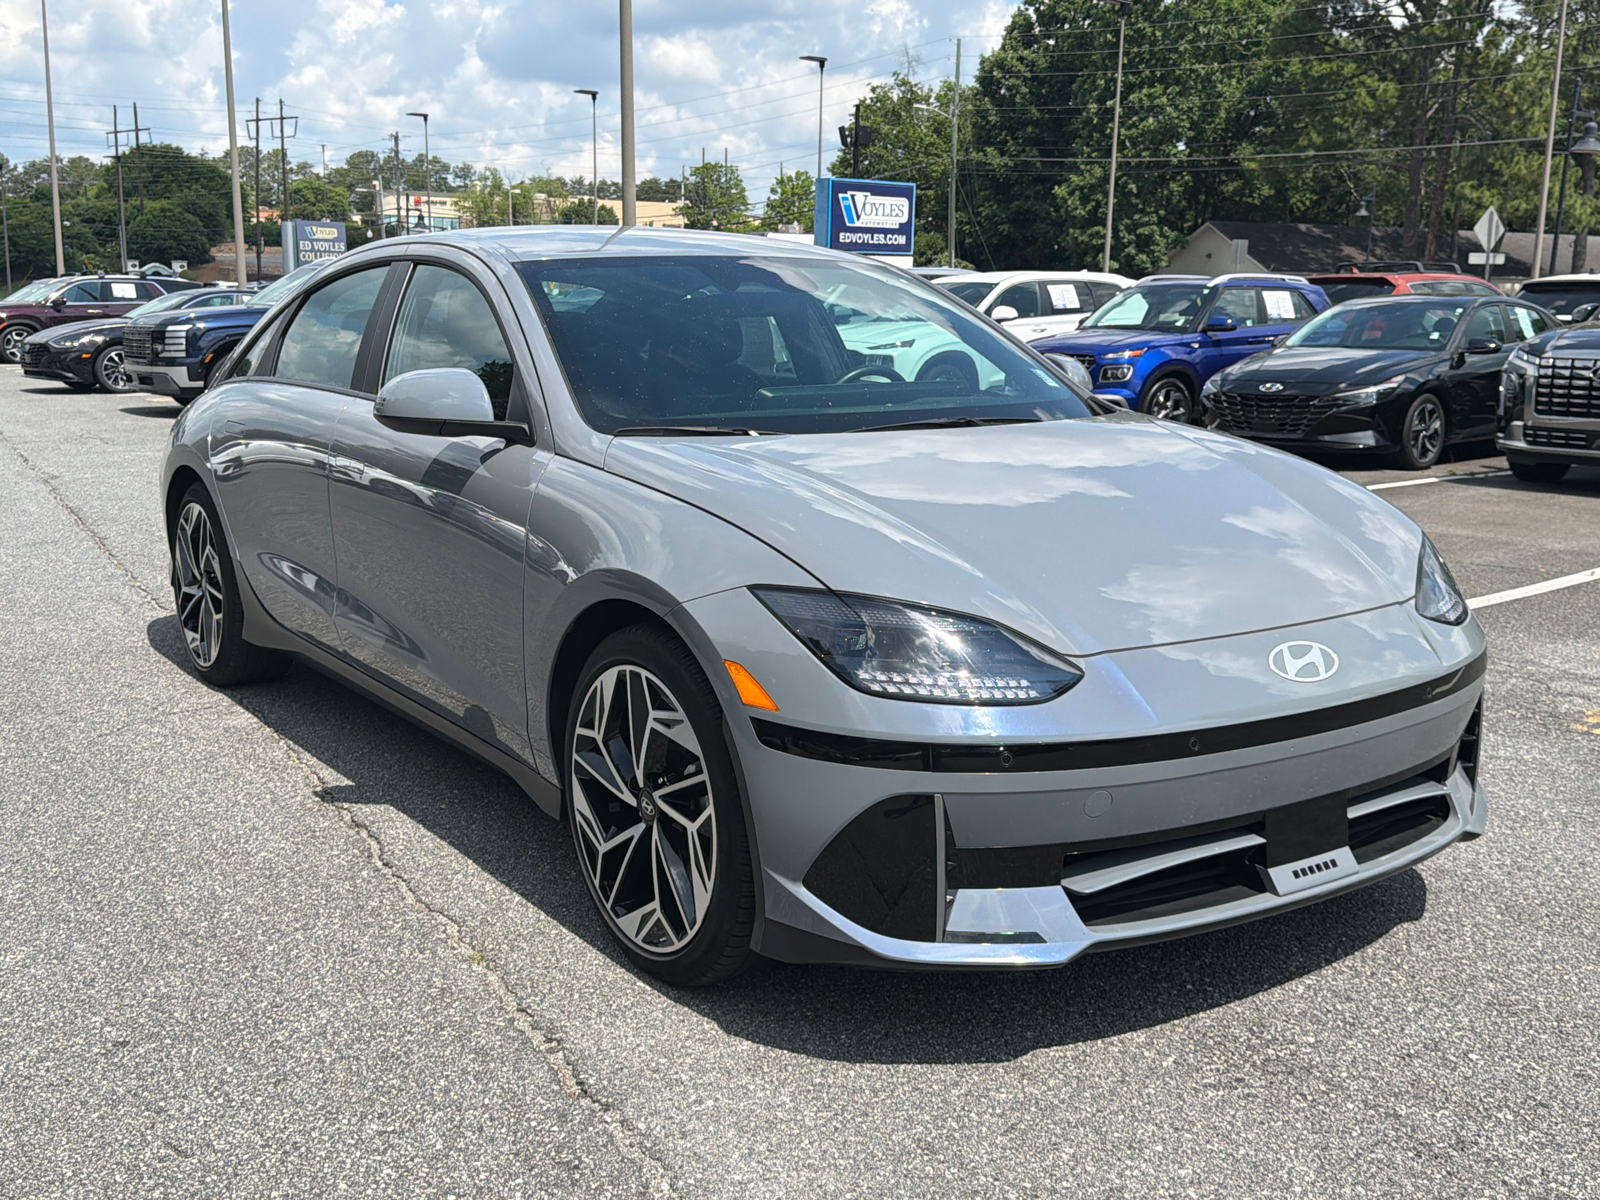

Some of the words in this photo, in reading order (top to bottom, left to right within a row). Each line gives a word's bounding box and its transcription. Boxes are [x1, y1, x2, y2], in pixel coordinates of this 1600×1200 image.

[840, 233, 906, 244] EDVOYLES.COM
[300, 241, 311, 250] ED
[313, 242, 345, 251] VOYLES
